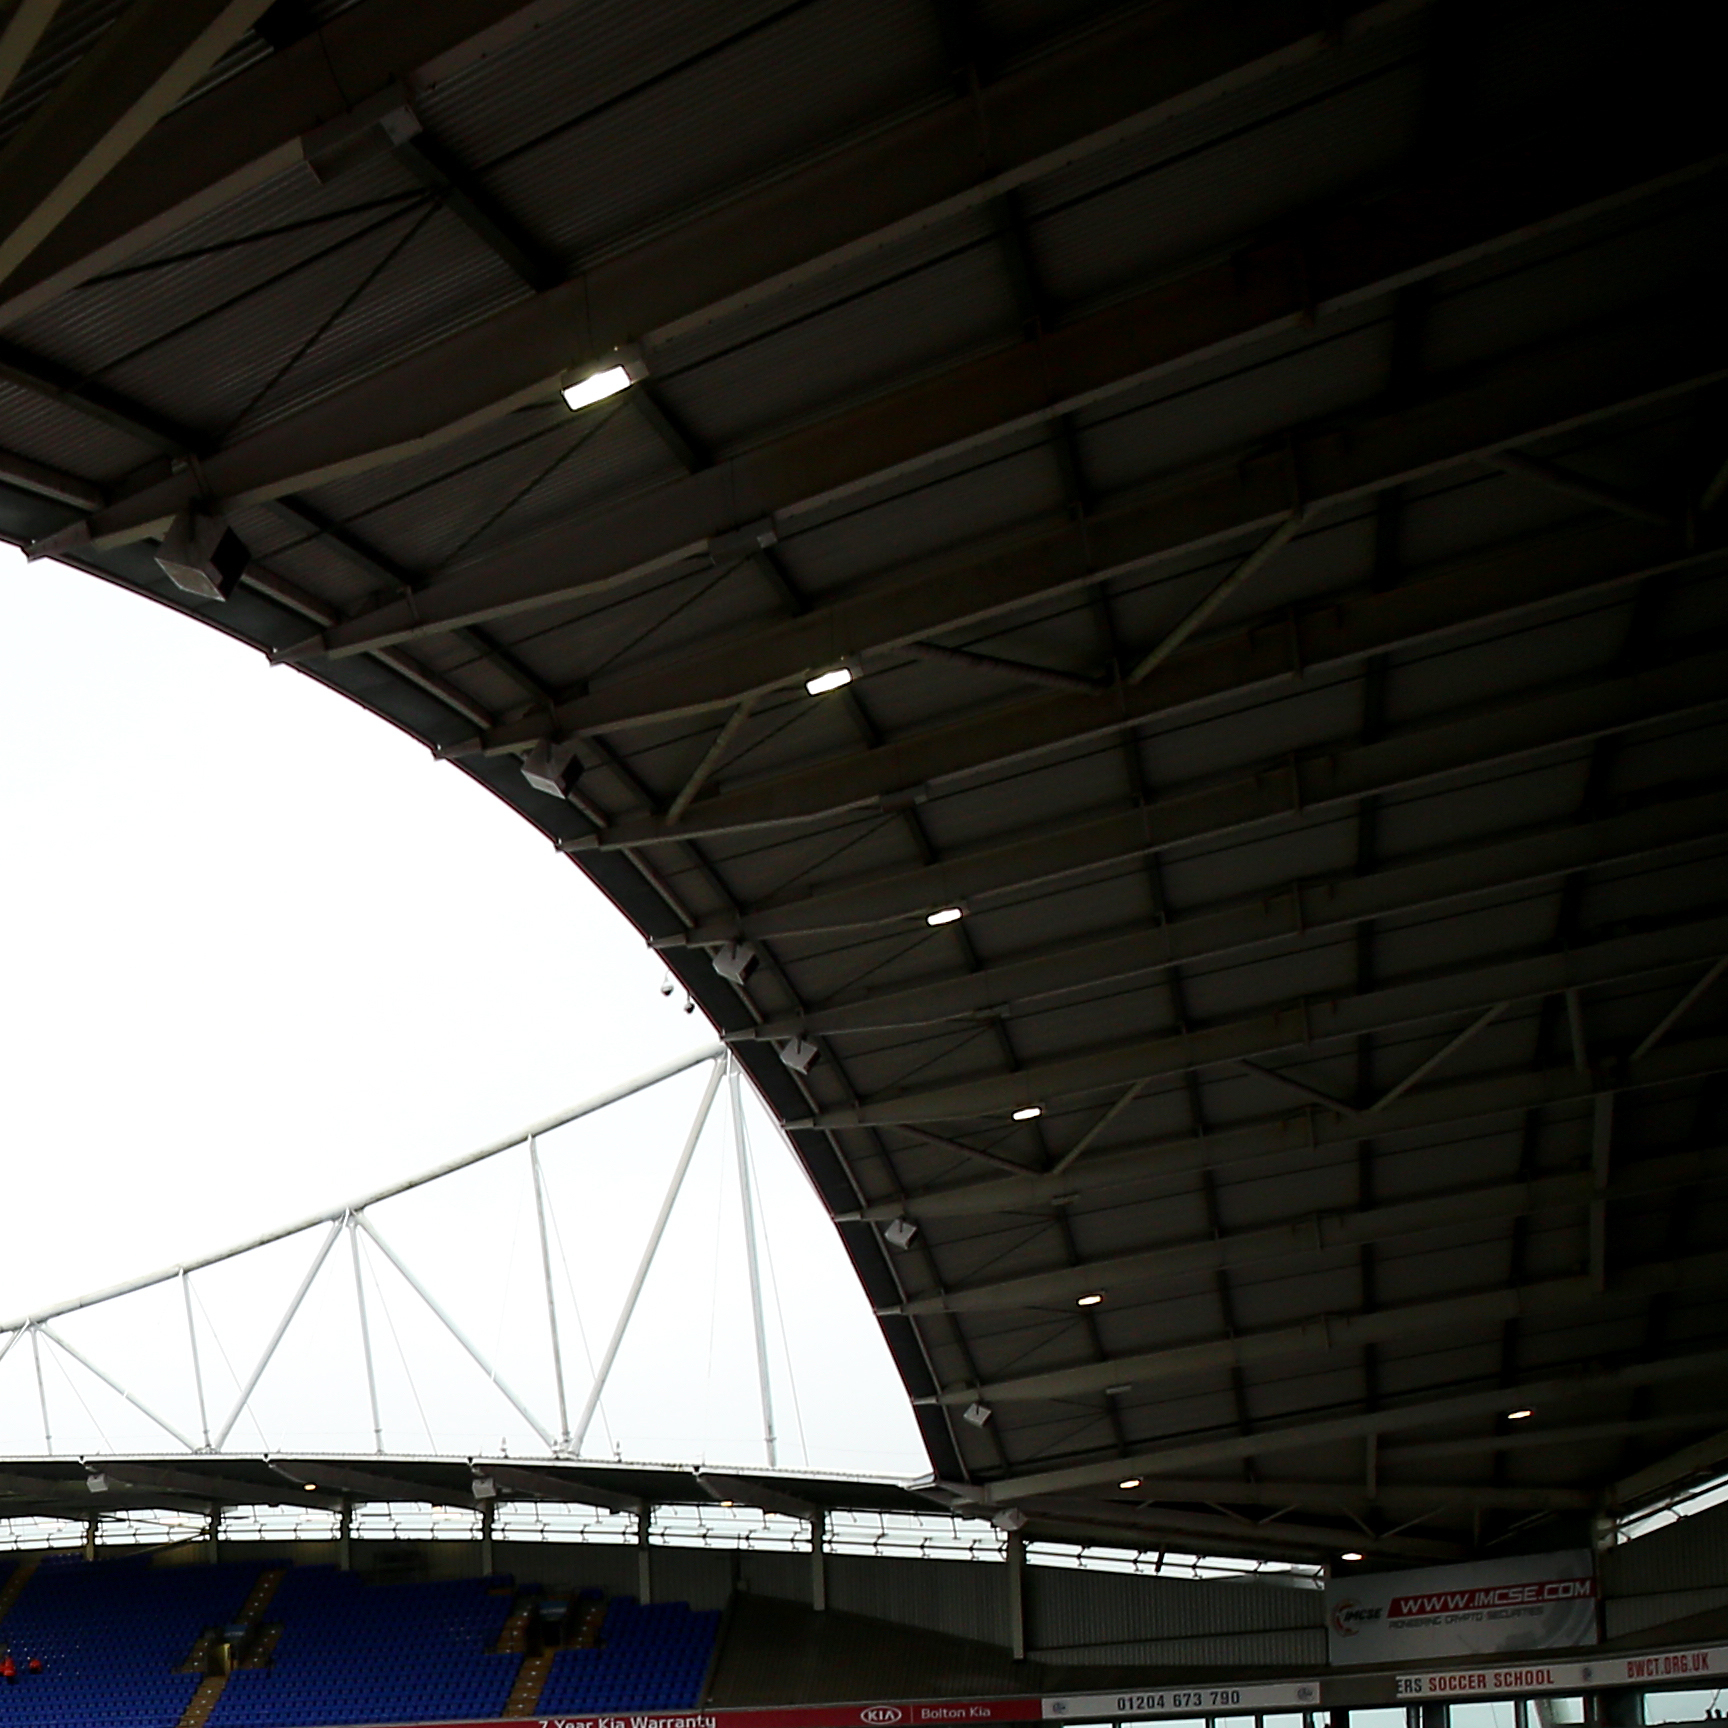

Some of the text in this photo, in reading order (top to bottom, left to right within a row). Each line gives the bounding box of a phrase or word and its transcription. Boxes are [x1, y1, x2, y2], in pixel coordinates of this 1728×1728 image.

[1400, 1579, 1591, 1614] WWW.IMCSE.COM
[1627, 1652, 1709, 1678] BWCT.ORG.UK
[1428, 1674, 1487, 1692] SOCCER
[1493, 1670, 1555, 1688] SCHOOL
[1117, 1690, 1240, 1711] 01204 673 790
[921, 1705, 991, 1720] Bolton Kia
